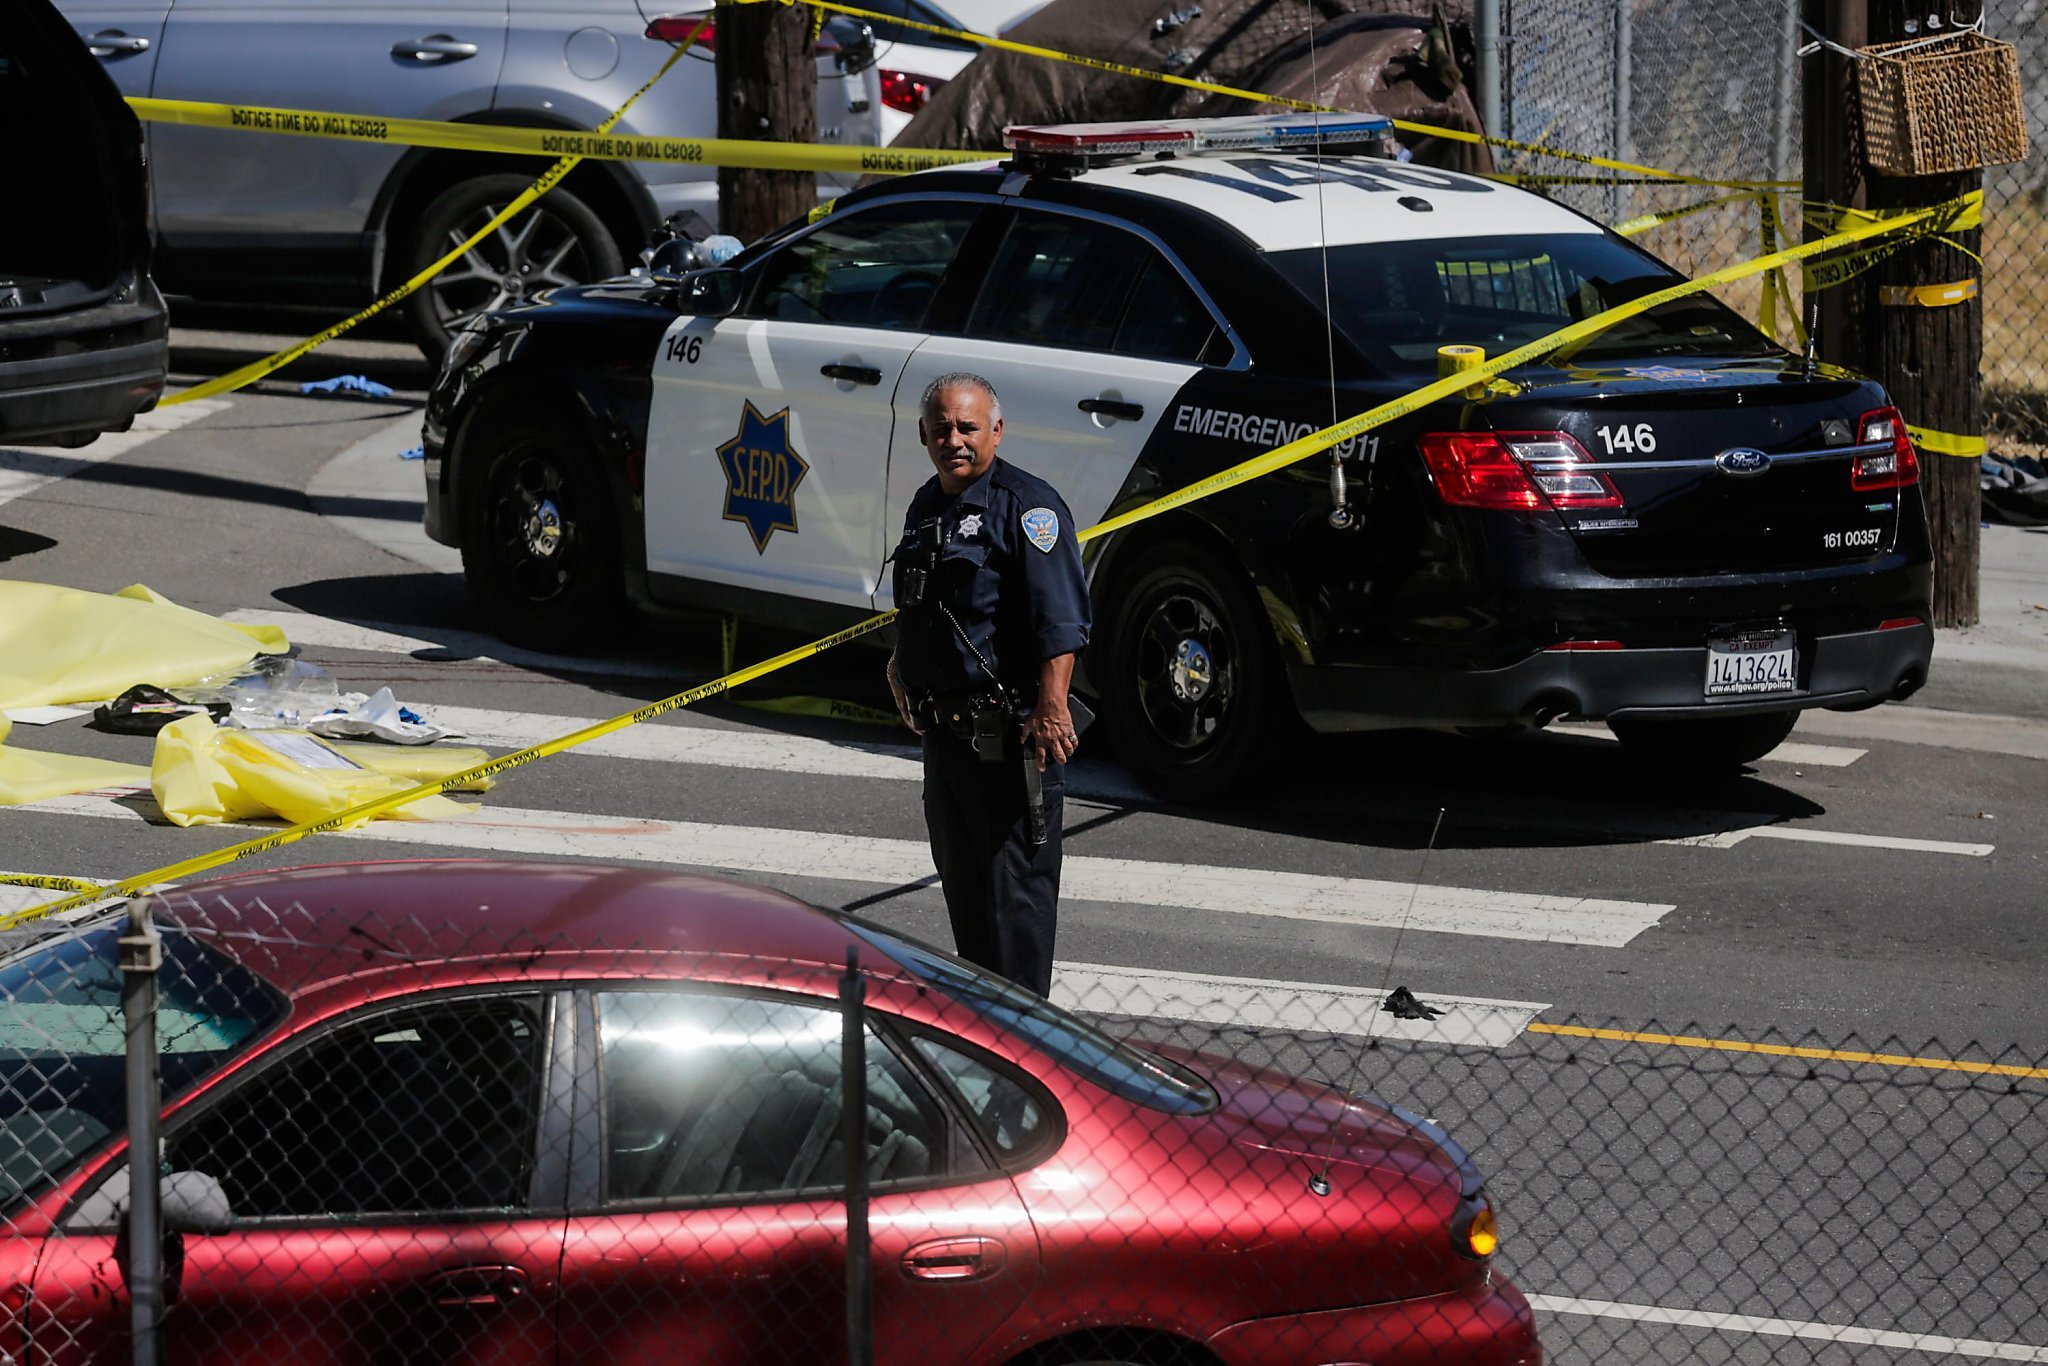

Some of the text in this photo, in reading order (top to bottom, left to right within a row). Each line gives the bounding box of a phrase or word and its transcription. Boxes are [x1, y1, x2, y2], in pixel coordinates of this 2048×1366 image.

[666, 334, 703, 364] 146
[1173, 404, 1322, 447] EMERGENC
[1338, 434, 1380, 463] 911
[1597, 422, 1657, 455] 146
[1731, 451, 1761, 468] Ford
[1823, 529, 1881, 548] 161 00357
[1729, 640, 1775, 652] CA EXEMPT
[1713, 654, 1788, 683] 1413624
[1710, 680, 1791, 693] www.sfgov.org/police
